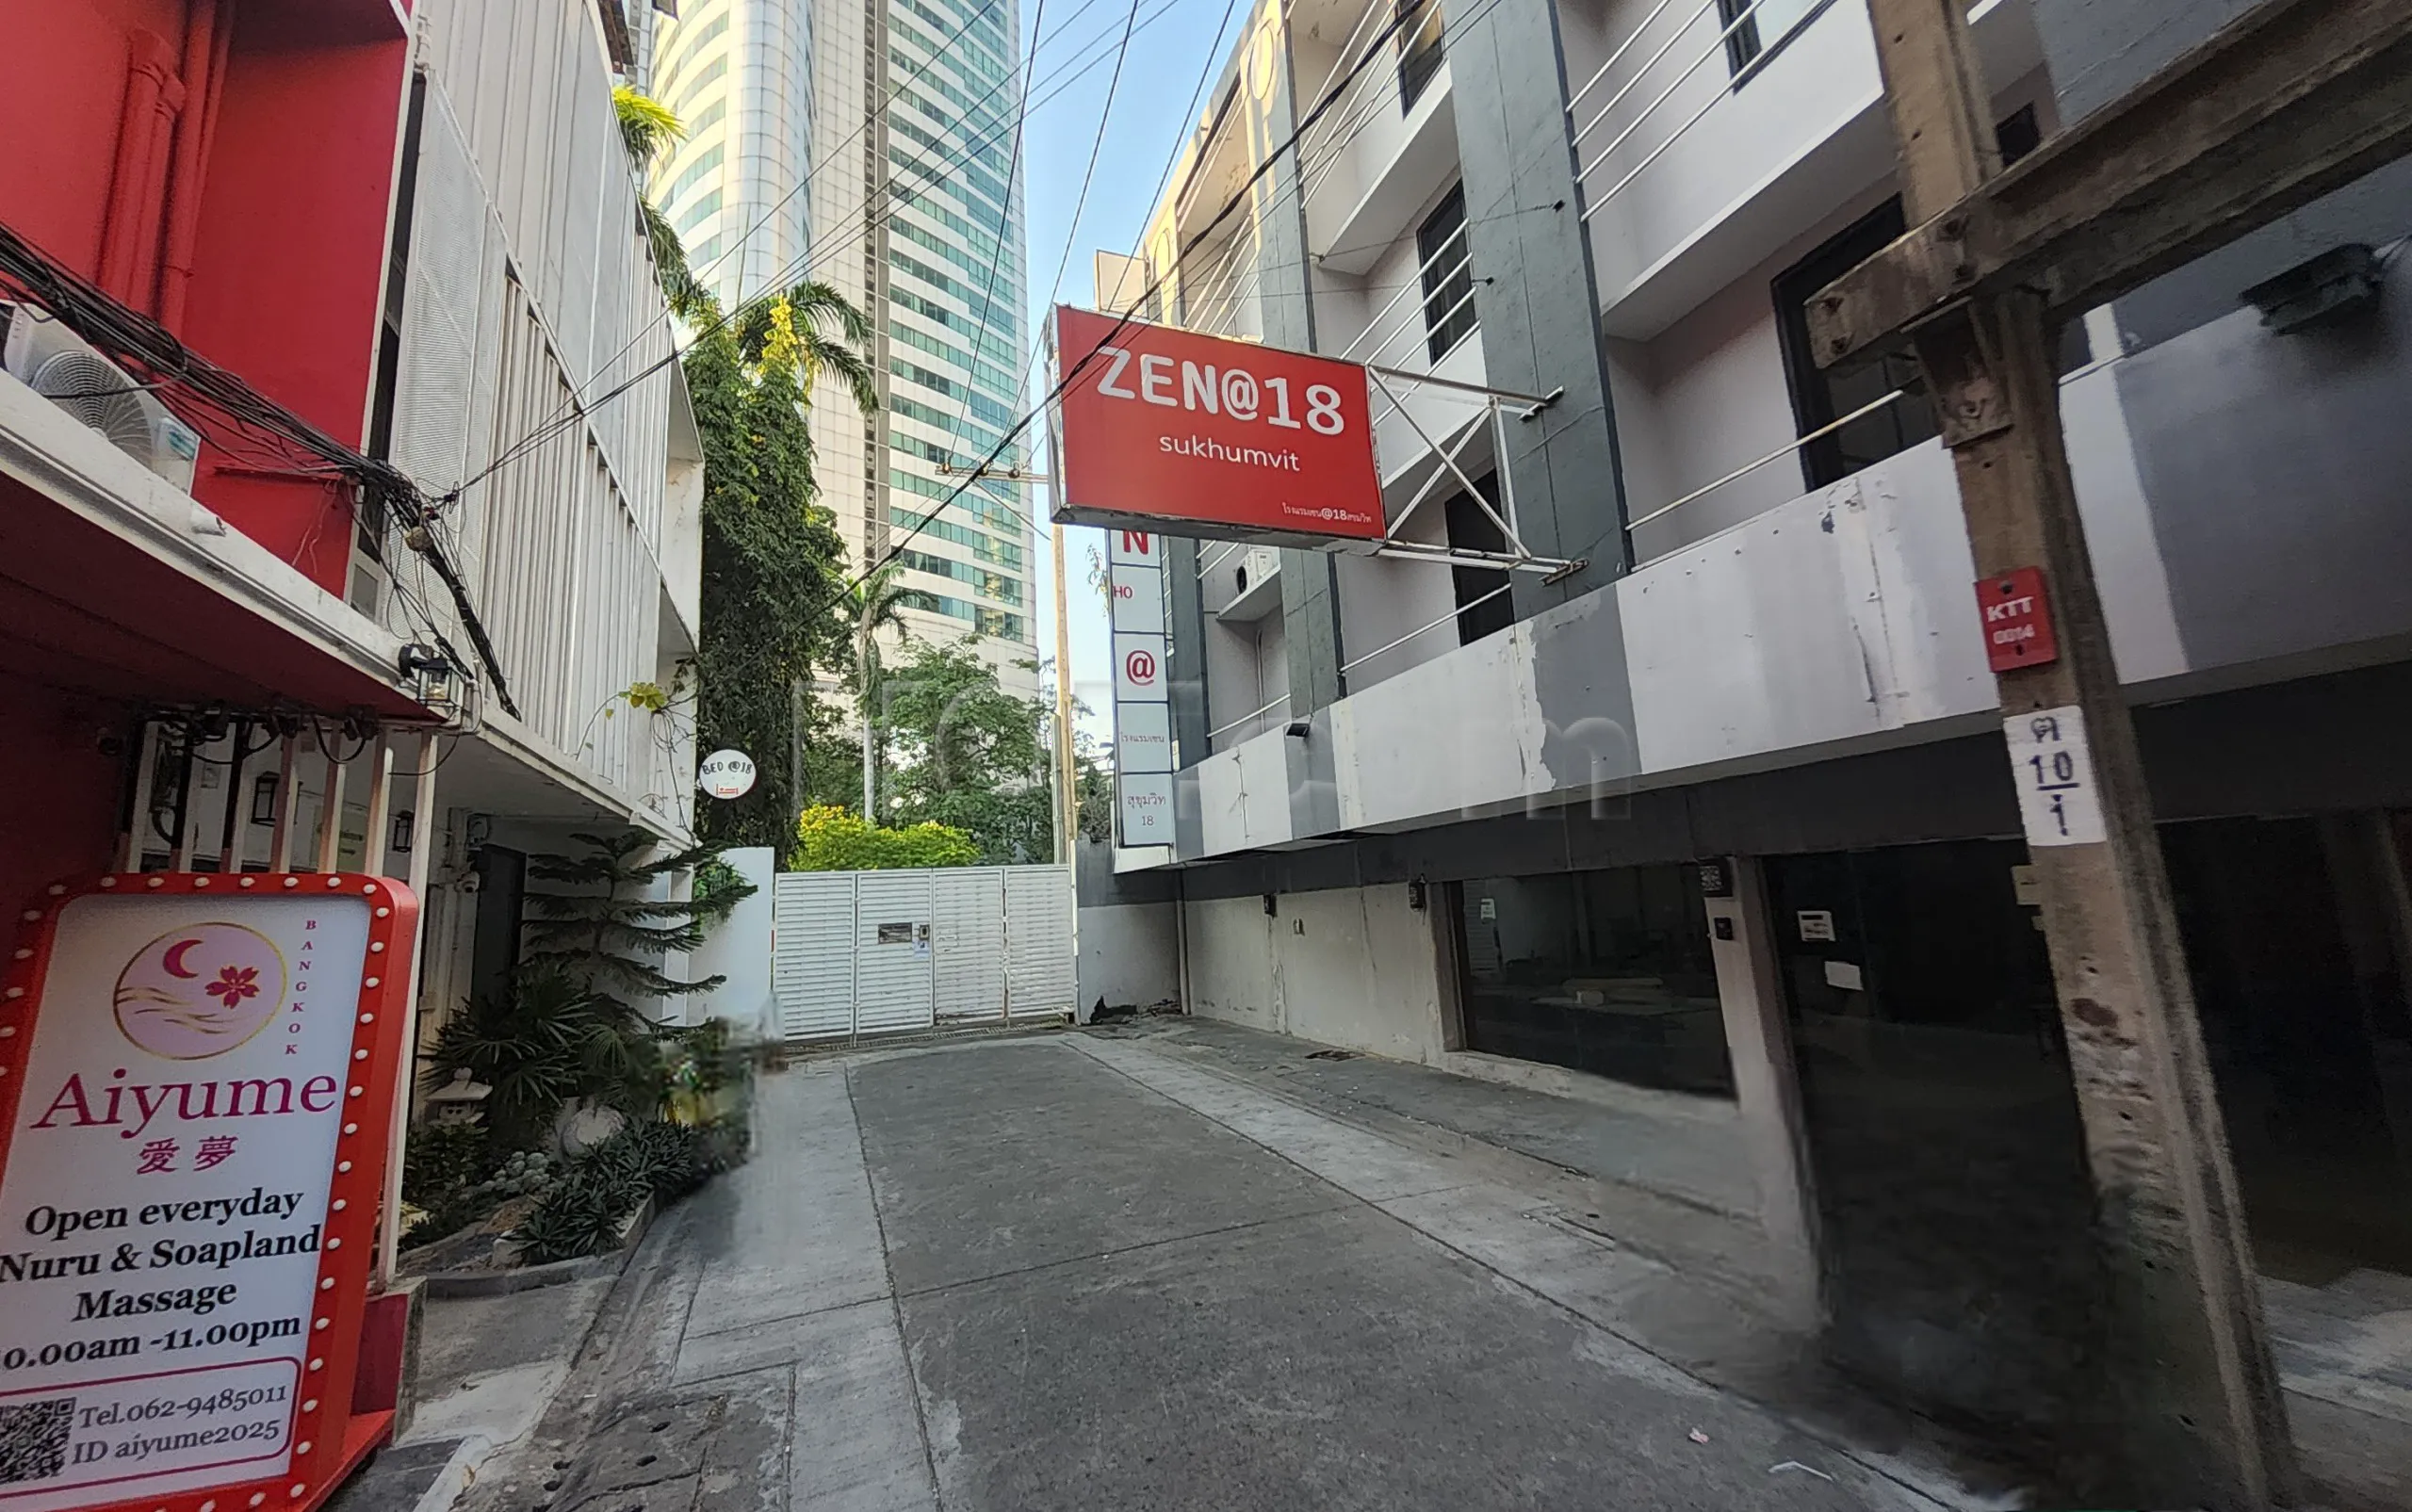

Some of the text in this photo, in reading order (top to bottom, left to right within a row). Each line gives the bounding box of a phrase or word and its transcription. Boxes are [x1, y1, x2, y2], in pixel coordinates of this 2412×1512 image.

[1096, 345, 1345, 436] ZEN@18
[1159, 433, 1301, 472] sukhumvit
[702, 761, 753, 774] BED @18
[2029, 751, 2073, 784] 10
[1141, 816, 1154, 826] 18
[285, 919, 317, 1056] BANGKOK
[30, 1067, 338, 1139] Aiyume
[24, 1187, 303, 1242] Open everyday
[0, 1226, 320, 1283] Nuru & Soapland
[72, 1279, 237, 1323] Massage
[1, 1336, 139, 1371] 0.00am
[78, 1384, 286, 1429] Tel.062-9485011
[72, 1418, 281, 1466] ID aiyume2025
